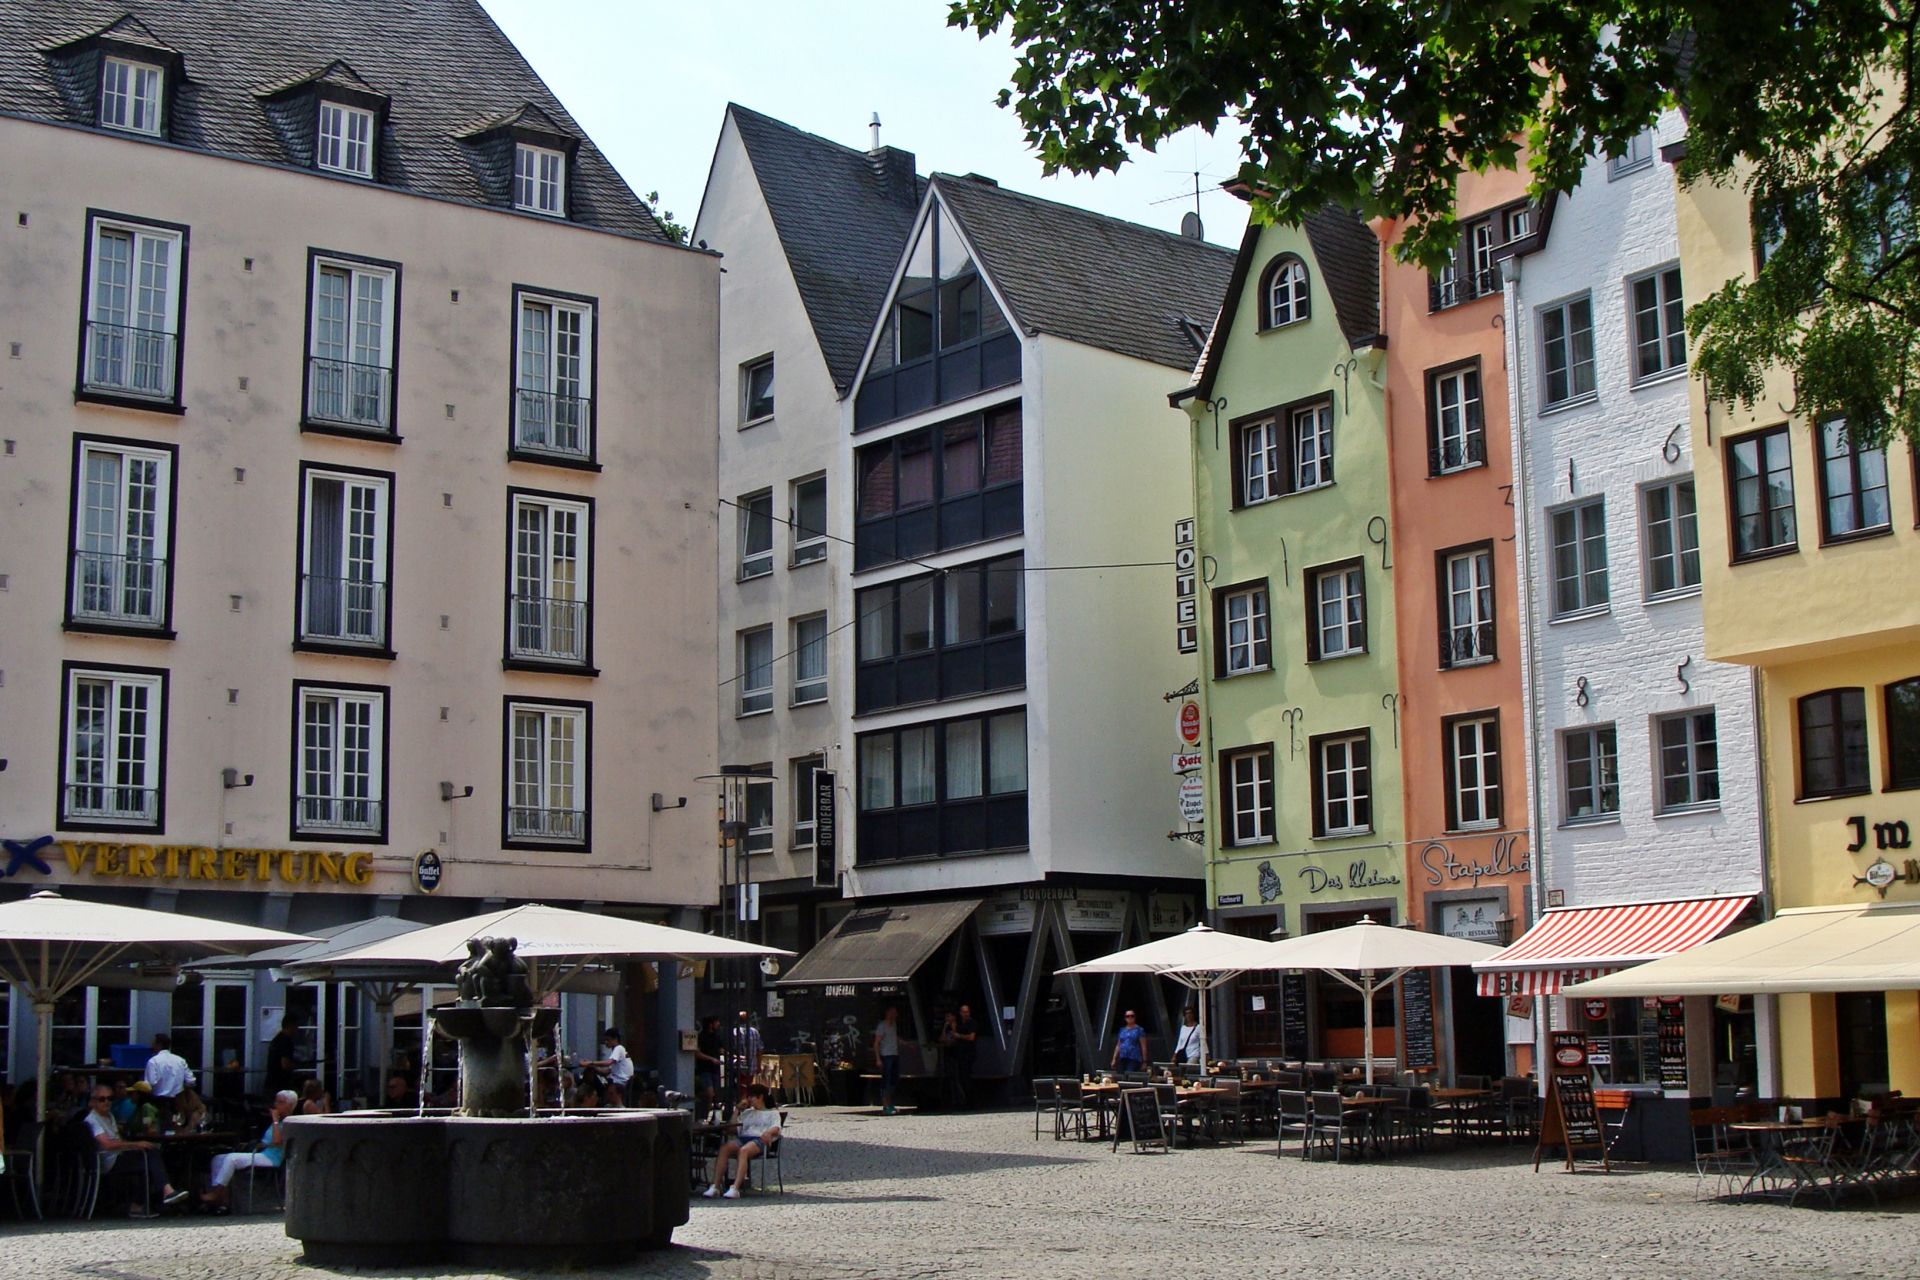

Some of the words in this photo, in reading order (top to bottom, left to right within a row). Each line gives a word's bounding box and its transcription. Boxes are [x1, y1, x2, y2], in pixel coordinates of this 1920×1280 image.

[1176, 522, 1197, 650] HOTEL
[820, 784, 833, 846] SONDERBAR
[0, 835, 54, 878] X
[59, 839, 375, 886] VERTRETUNG
[1298, 865, 1343, 893] Das
[1348, 858, 1400, 889] kleine
[1022, 887, 1076, 900] SONDERBAR
[1468, 928, 1500, 937] RESTAURAN
[1510, 997, 1529, 1014] Eis
